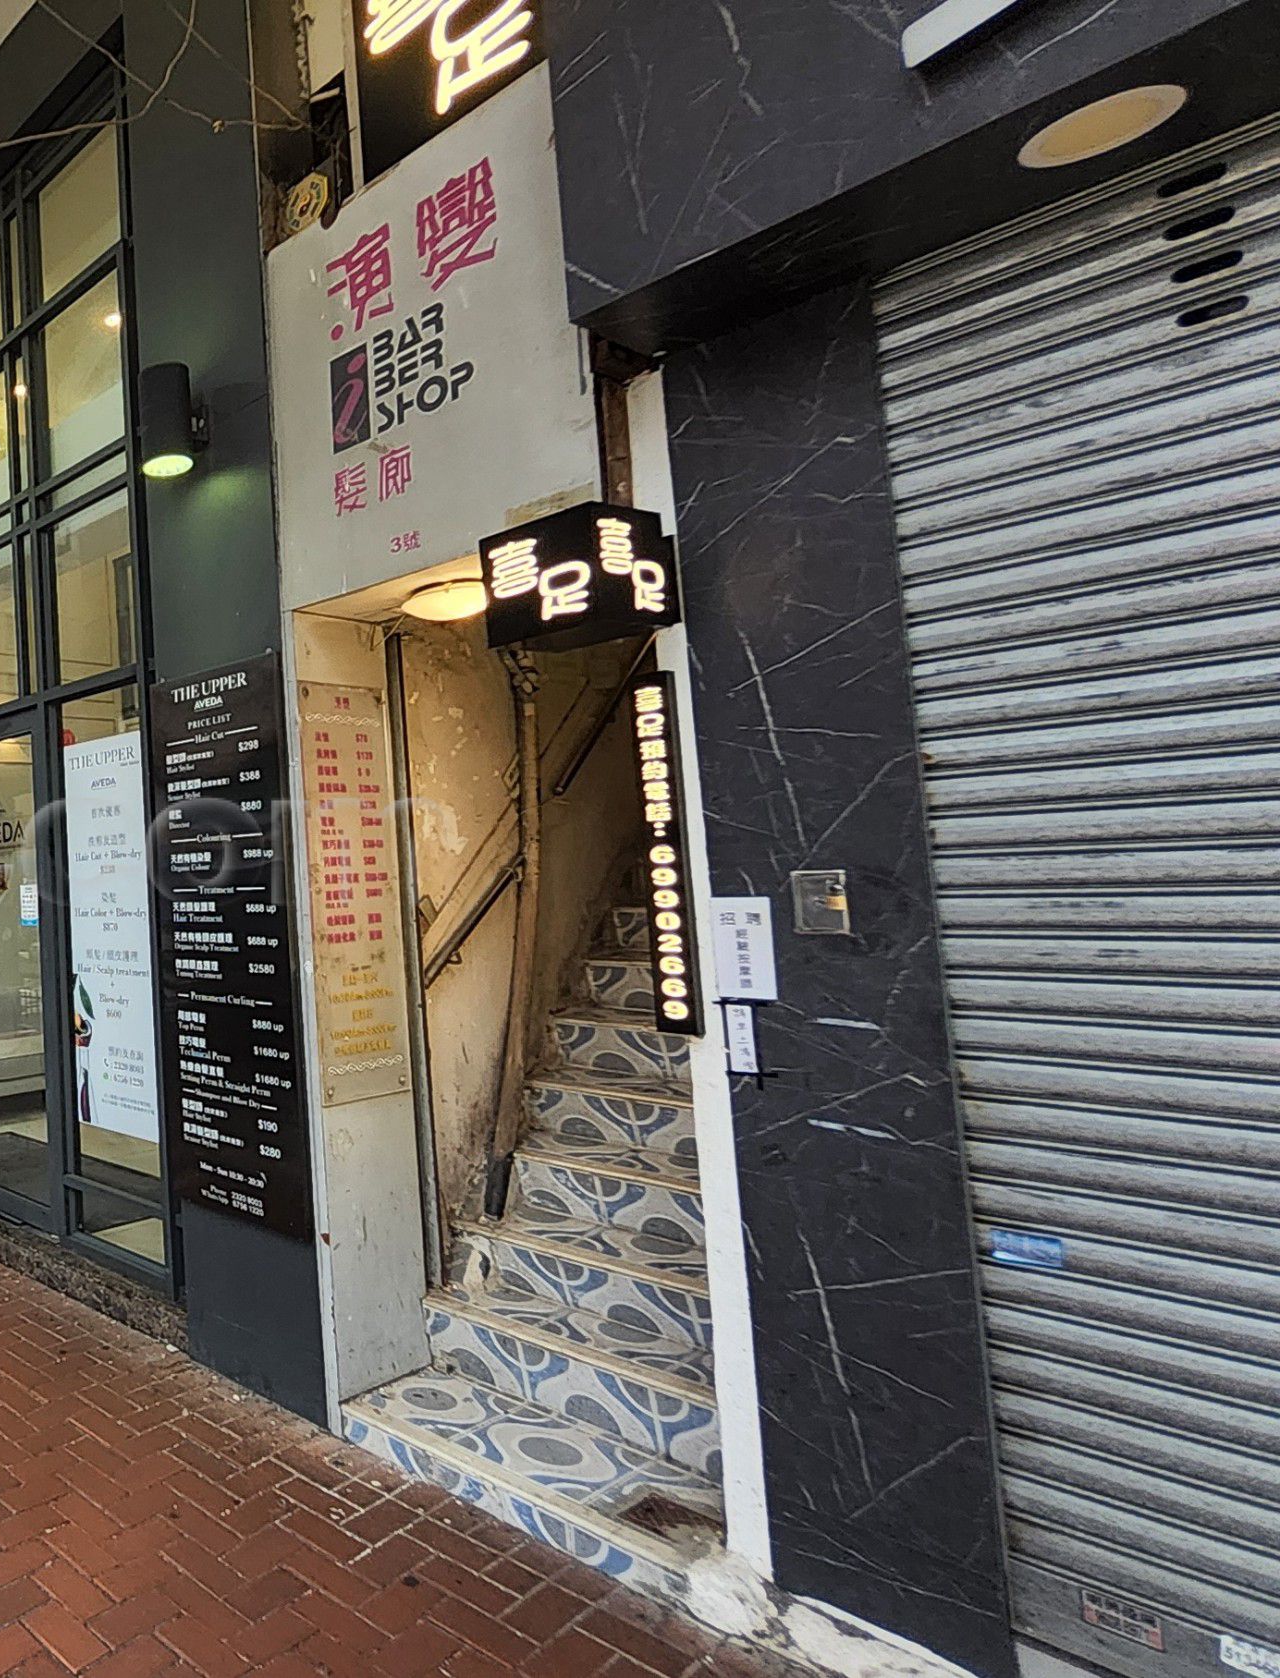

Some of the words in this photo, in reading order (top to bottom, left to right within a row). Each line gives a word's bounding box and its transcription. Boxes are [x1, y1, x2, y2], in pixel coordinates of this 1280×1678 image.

[326, 156, 498, 342] 演變
[372, 301, 445, 364] BAR
[373, 340, 445, 400] BER
[375, 360, 476, 435] SHOP
[333, 443, 413, 518] 髮廊
[389, 530, 422, 555] 3號
[595, 517, 666, 613] 喜足
[487, 537, 592, 621] 喜足
[171, 684, 200, 703] THE
[200, 672, 248, 697] UPPER
[193, 695, 224, 711] AVEDA
[186, 717, 212, 731] PRICE
[212, 713, 233, 725] LIST
[194, 733, 210, 745] Hair
[210, 730, 225, 741] Cut
[237, 739, 260, 752] $298
[68, 754, 94, 771] THE
[94, 745, 136, 766] UPPER
[90, 776, 117, 788] AVEDA
[239, 769, 261, 782] $388
[75, 852, 90, 862] Hair
[90, 850, 102, 861] Cut
[262, 849, 274, 859] up
[198, 885, 235, 895] Treatment
[74, 907, 90, 918] Hair
[90, 907, 108, 918] Color
[115, 907, 147, 921] Blow-dry
[265, 904, 277, 915] up
[173, 913, 188, 923] Hair
[188, 913, 224, 923] Treatment
[267, 937, 279, 949] up
[77, 962, 92, 973] Hair
[96, 963, 115, 978] Scalp
[115, 967, 150, 978] treatment
[248, 963, 276, 975] $2580
[98, 993, 130, 1007] Blow-dry
[189, 990, 227, 1004] Permanent
[227, 994, 256, 1007] Curling
[272, 1022, 284, 1033] up
[179, 1046, 212, 1060] Technical
[211, 1051, 232, 1063] Perm
[278, 1050, 290, 1061] up
[201, 1075, 219, 1087] Perm
[251, 1085, 272, 1098] Perm
[280, 1078, 292, 1090] up
[248, 1098, 261, 1109] Dry
[257, 1118, 279, 1133] $190
[259, 1144, 282, 1159] $280
